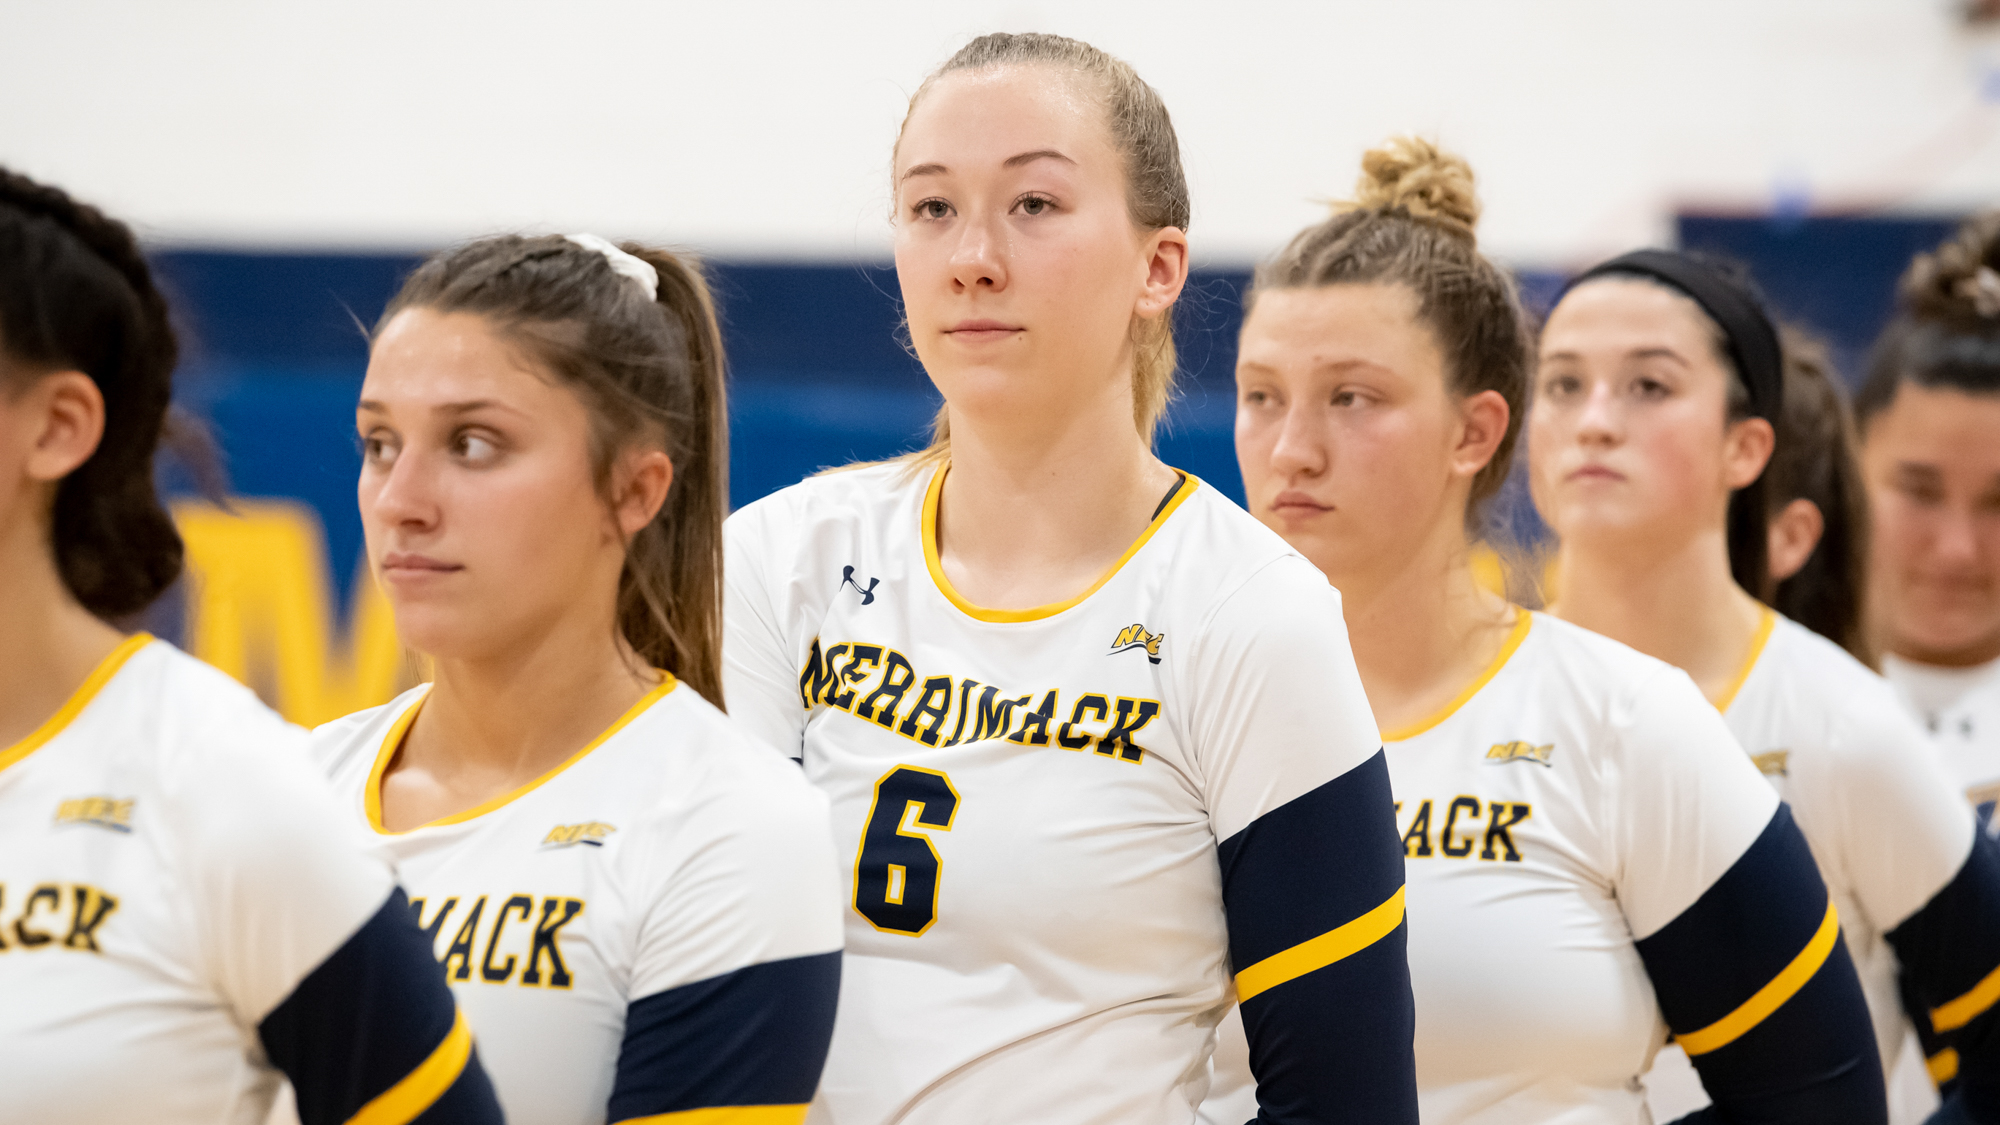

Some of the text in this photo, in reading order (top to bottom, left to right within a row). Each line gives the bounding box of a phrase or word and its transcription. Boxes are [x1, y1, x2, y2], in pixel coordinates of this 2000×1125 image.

[800, 637, 1162, 765] MERRIMACK
[851, 763, 961, 938] 6
[1393, 794, 1532, 862] ACK
